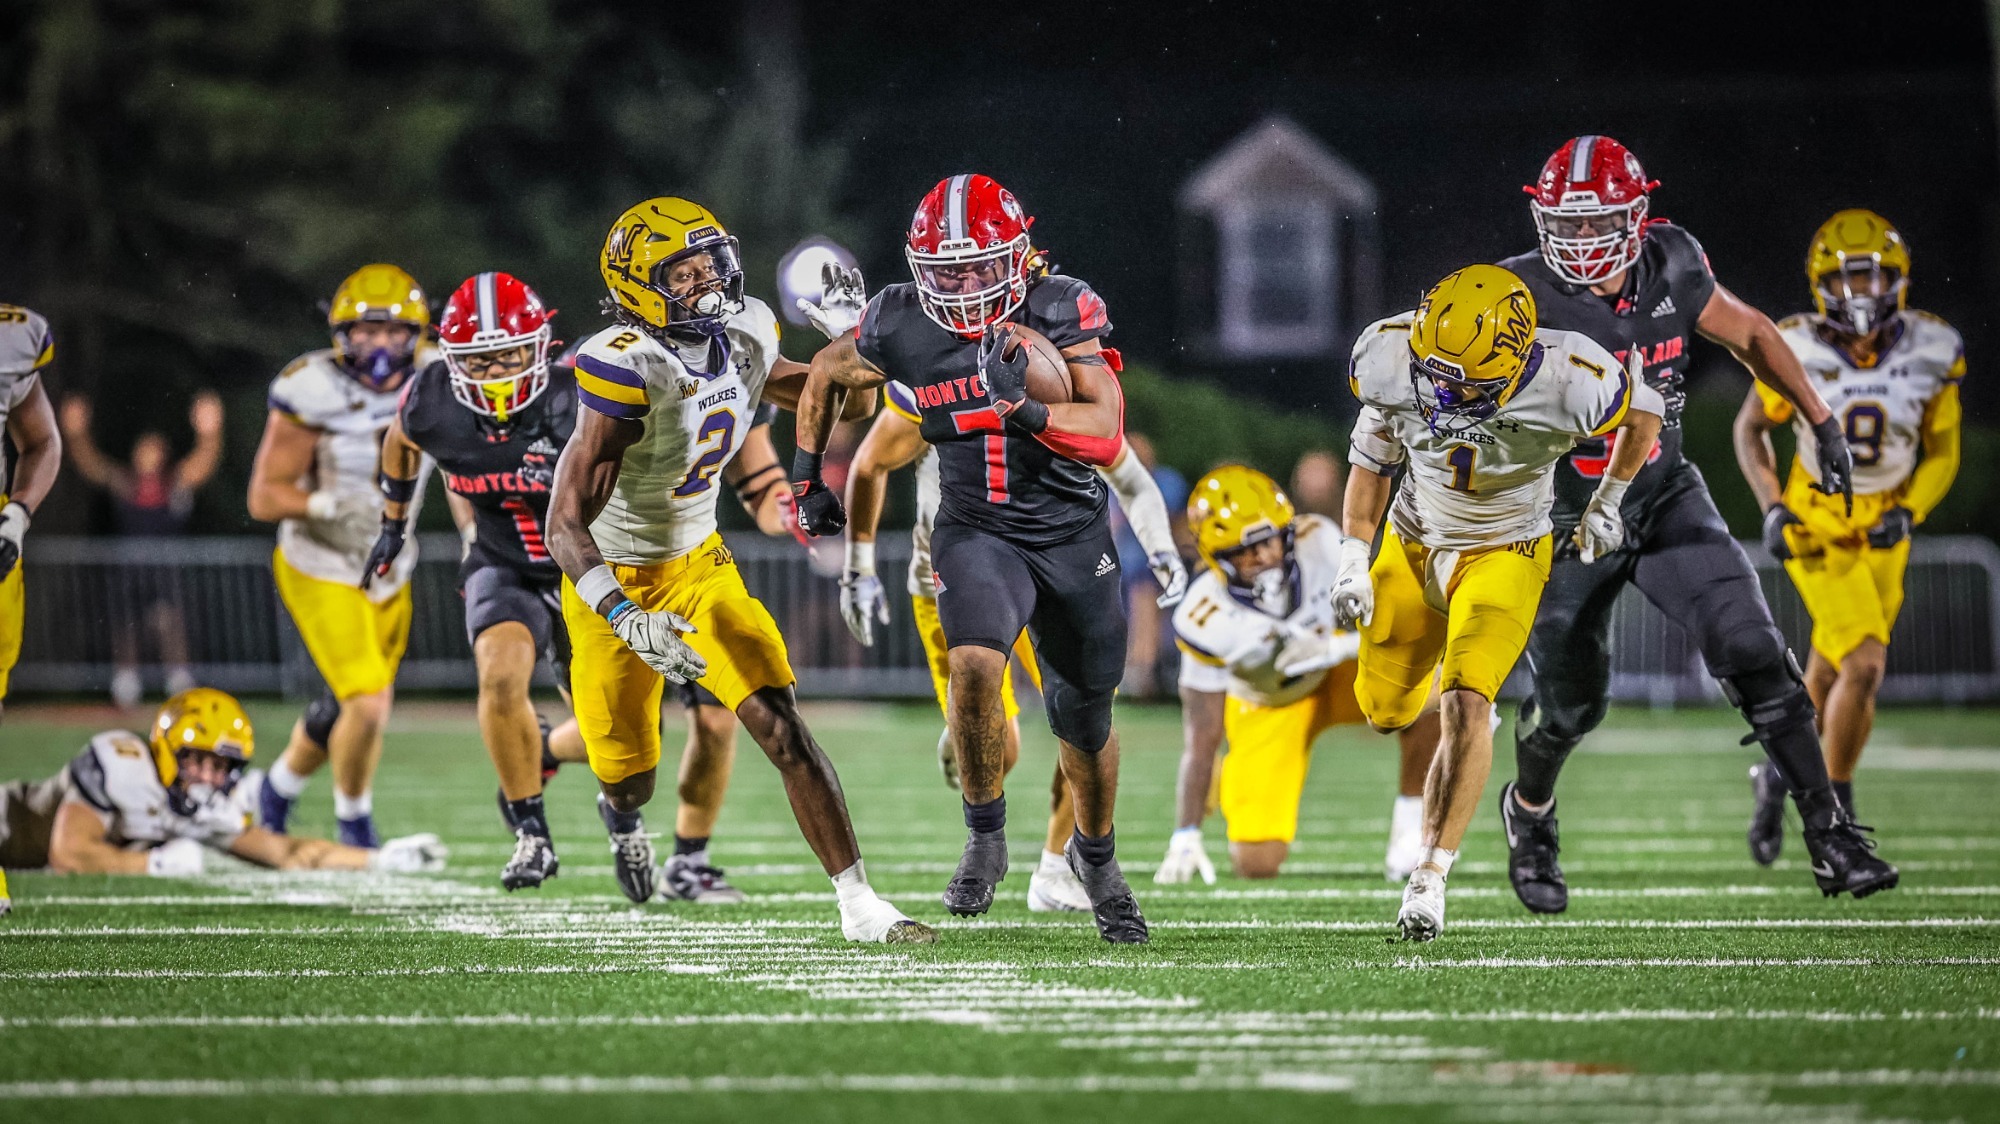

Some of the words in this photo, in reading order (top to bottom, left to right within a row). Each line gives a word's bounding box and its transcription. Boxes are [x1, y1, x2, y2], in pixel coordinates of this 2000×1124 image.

[690, 229, 716, 240] FAMILY
[1494, 296, 1532, 357] W
[606, 332, 640, 352] 2
[1613, 336, 1683, 367] TLAIR
[1429, 360, 1458, 375] FAMILY
[1568, 354, 1606, 381] 1
[680, 379, 699, 400] W
[698, 386, 737, 412] WILKES
[1440, 430, 1495, 446] WILKES
[1843, 400, 1888, 468] 9
[671, 407, 736, 499] 2
[950, 405, 1010, 504] 7
[1443, 443, 1478, 494] 1
[1095, 563, 1117, 577] adidas
[1188, 597, 1220, 628] 11
